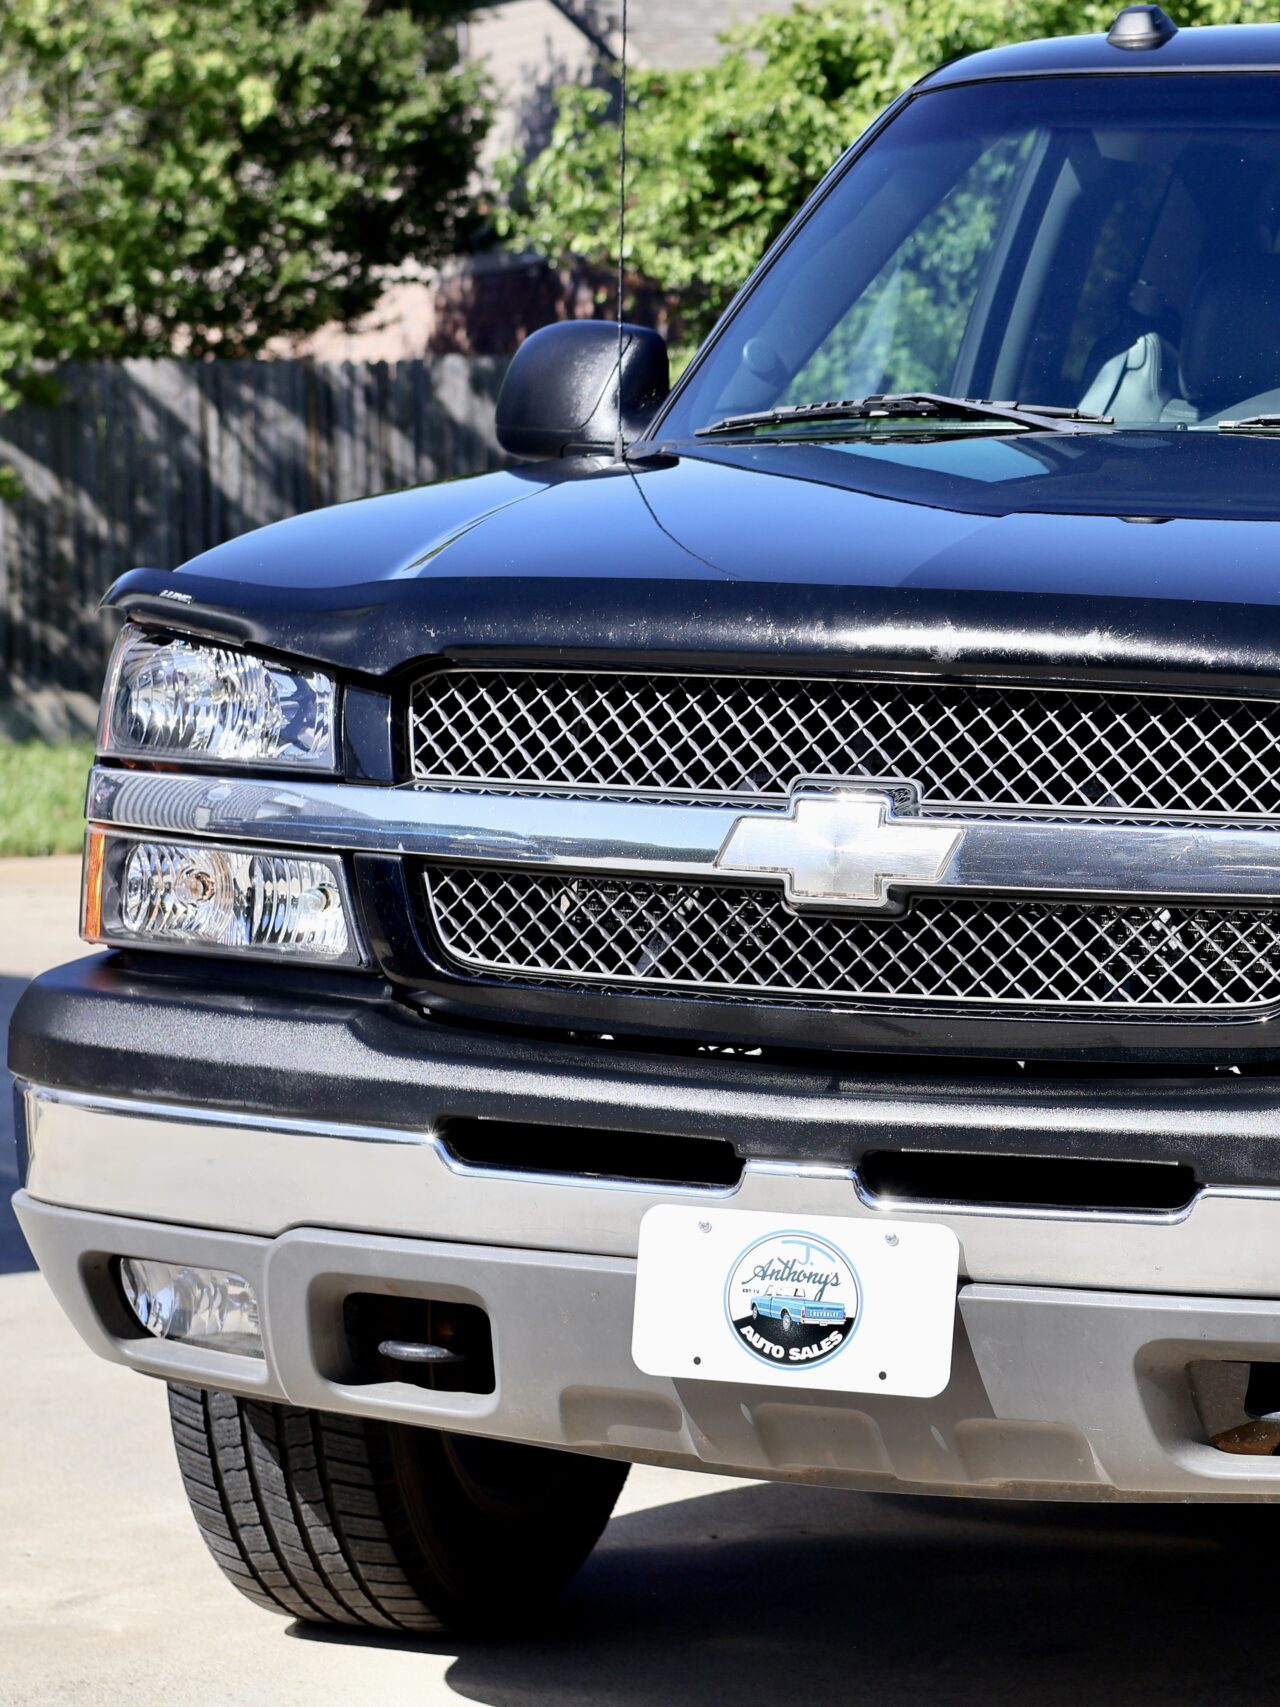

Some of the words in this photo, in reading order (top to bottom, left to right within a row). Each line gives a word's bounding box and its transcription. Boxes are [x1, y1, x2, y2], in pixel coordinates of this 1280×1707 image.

[741, 1256, 842, 1302] Anthony's
[739, 1325, 786, 1359] AUTO
[788, 1330, 844, 1361] SALES
